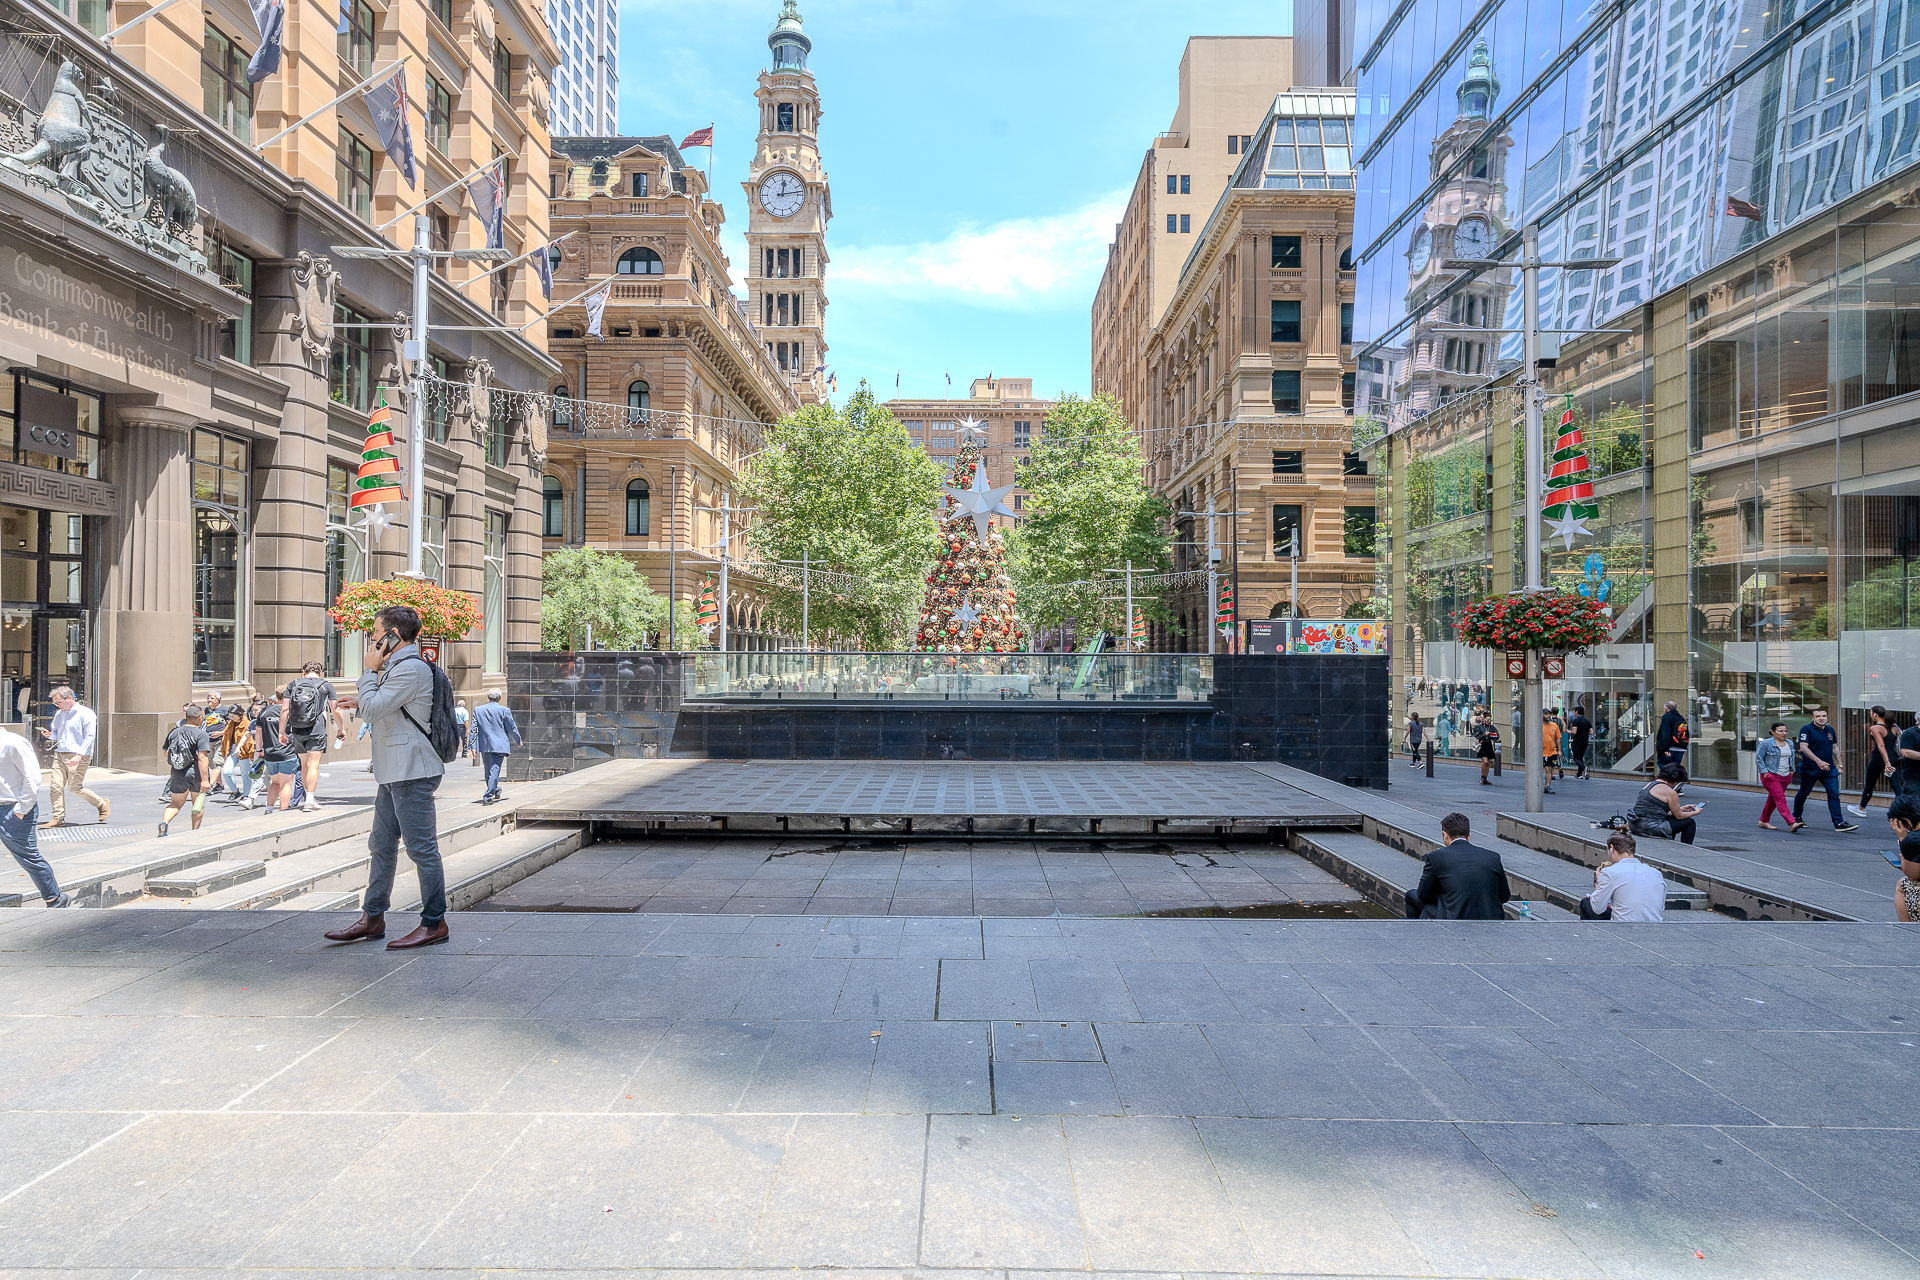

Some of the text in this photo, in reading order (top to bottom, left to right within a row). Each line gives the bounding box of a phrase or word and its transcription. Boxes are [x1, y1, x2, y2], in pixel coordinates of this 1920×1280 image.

[0, 291, 188, 388] Bank of Australia
[15, 252, 173, 343] Commonwealth
[30, 425, 71, 448] COS
